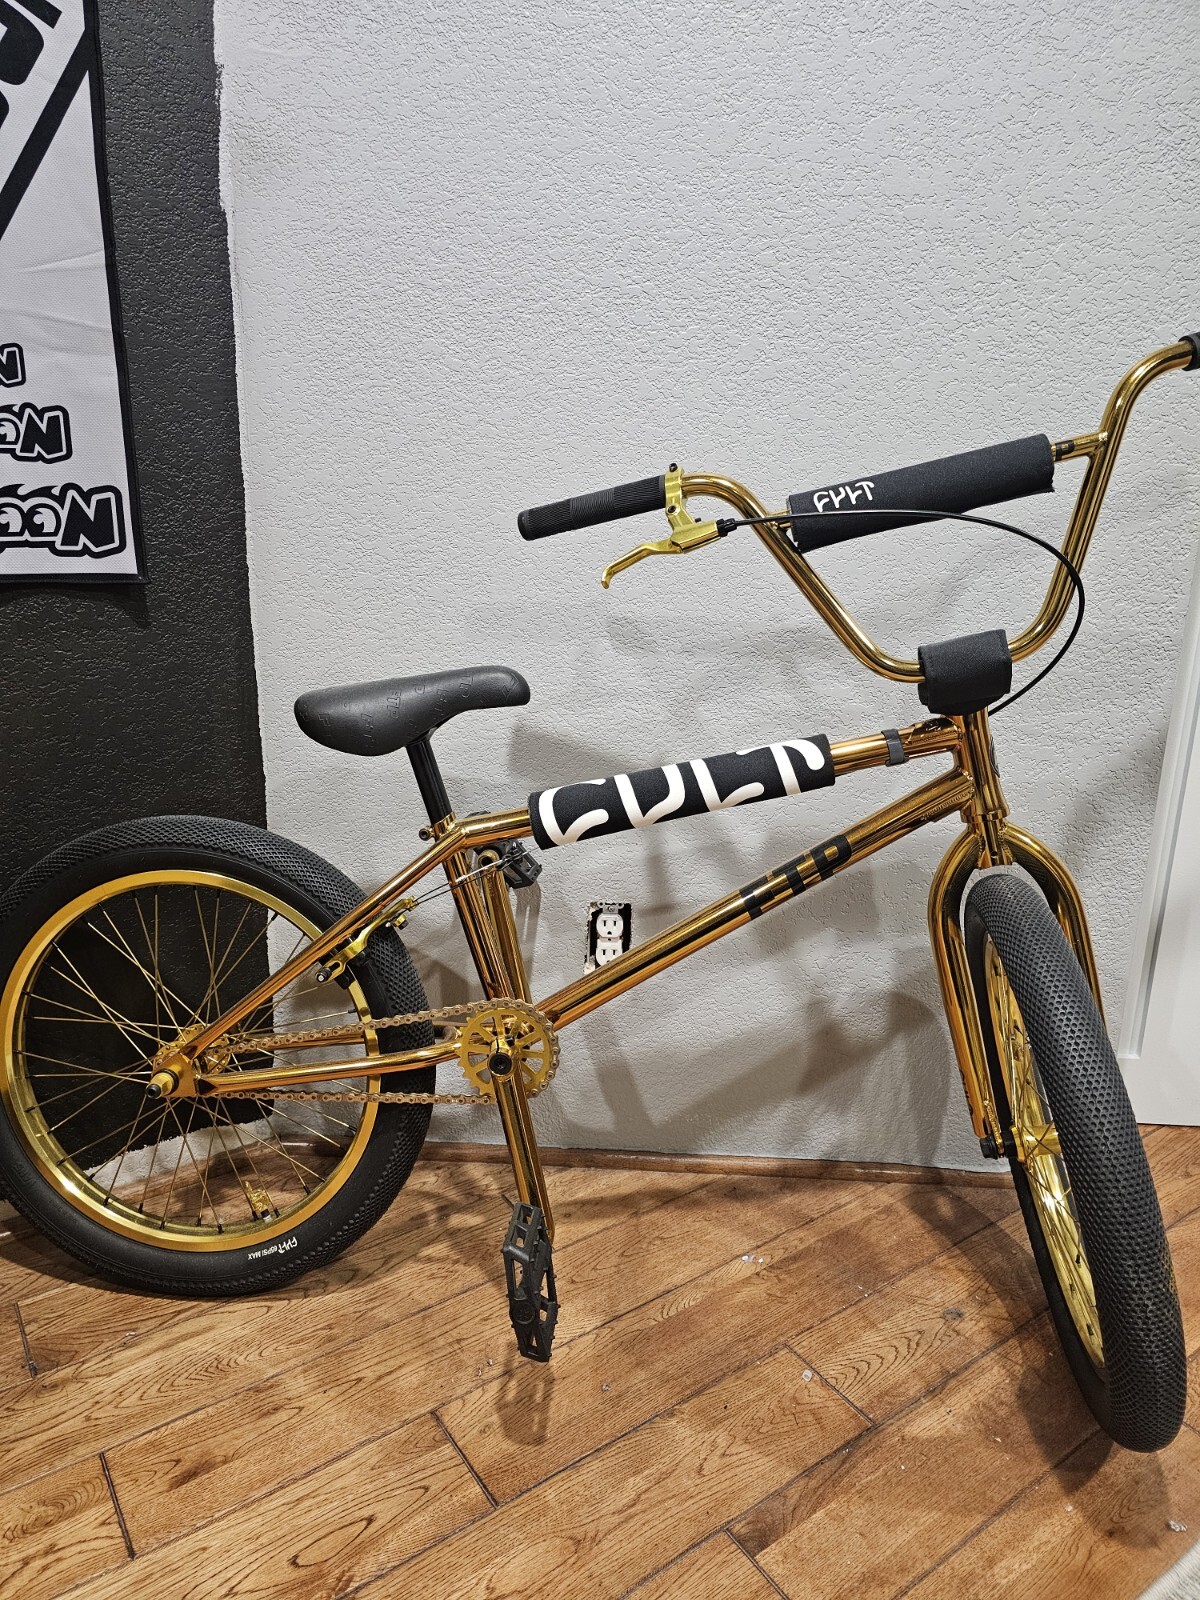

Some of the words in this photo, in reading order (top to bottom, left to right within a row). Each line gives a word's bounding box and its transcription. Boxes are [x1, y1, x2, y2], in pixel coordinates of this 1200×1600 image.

[813, 481, 875, 513] CULT
[538, 739, 825, 847] CULT
[247, 1250, 262, 1260] MAX
